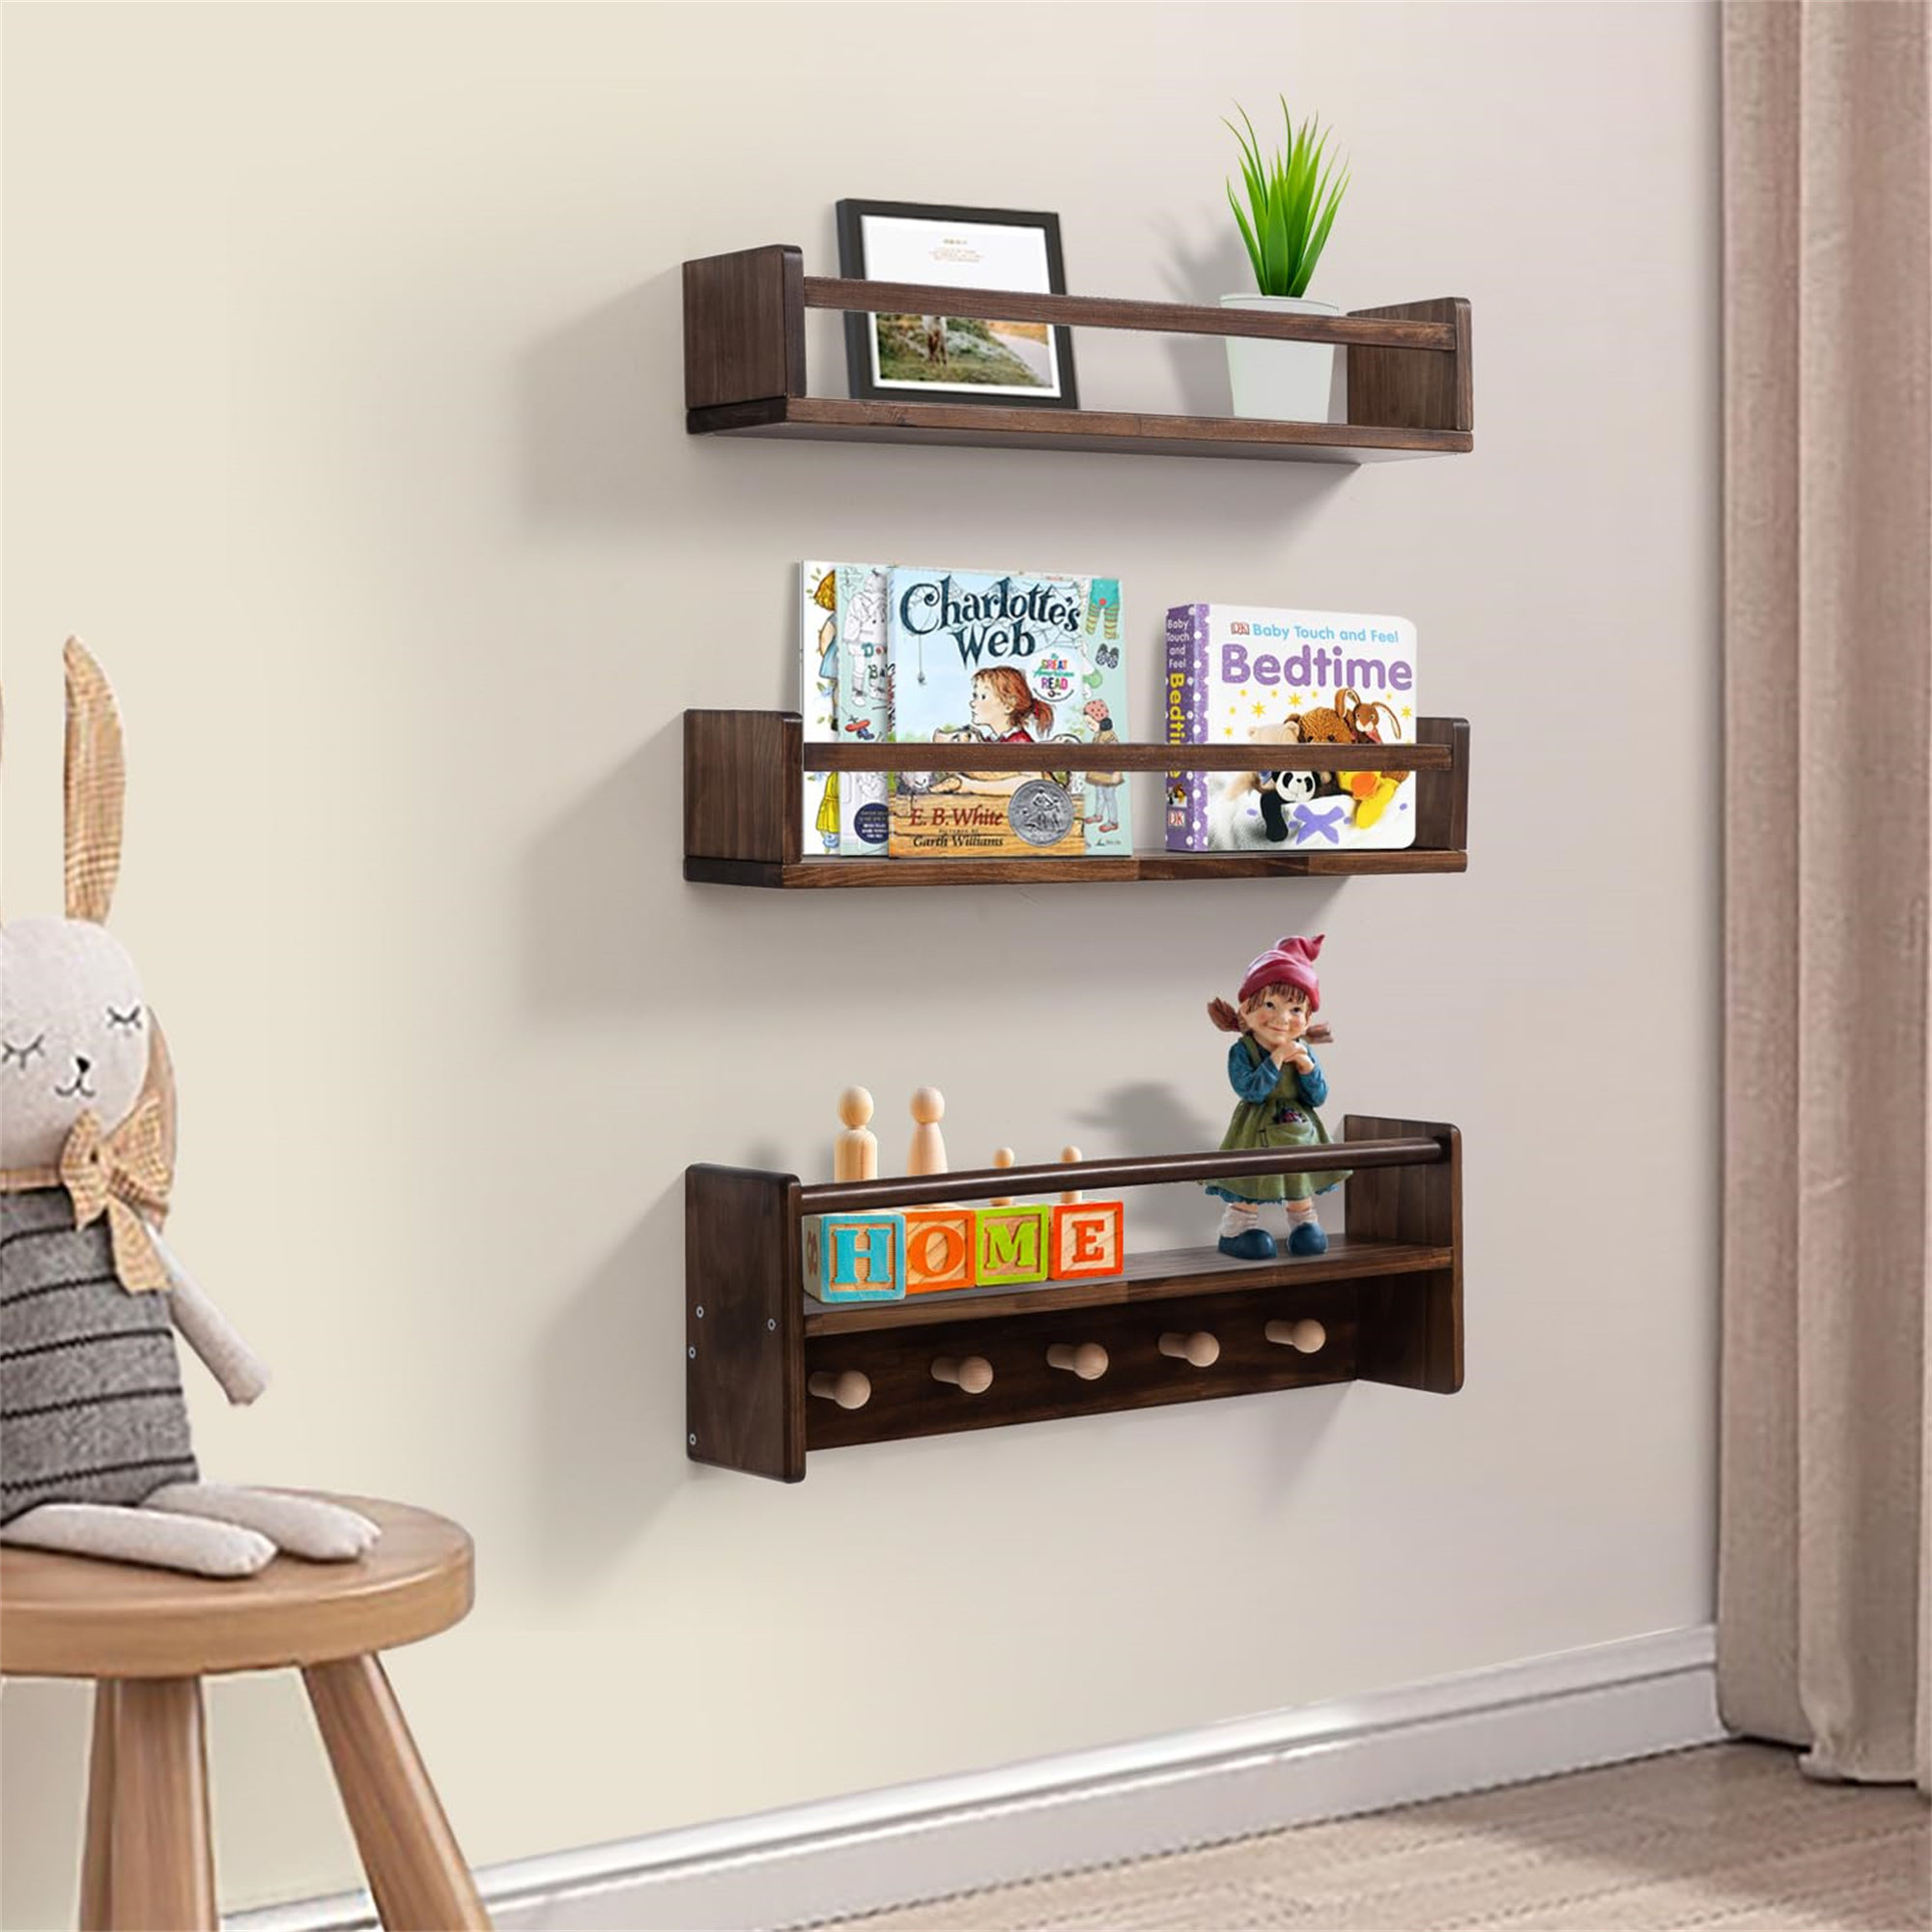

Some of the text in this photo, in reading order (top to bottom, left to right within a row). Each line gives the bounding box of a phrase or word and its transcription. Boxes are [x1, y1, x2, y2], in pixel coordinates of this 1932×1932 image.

[900, 575, 1081, 635] Charlotte's
[1167, 618, 1189, 630] Baby
[1166, 633, 1190, 642] Touch
[1253, 623, 1399, 643] Baby Touch and Feel
[949, 619, 1036, 668] Web
[1169, 644, 1185, 656] and
[1041, 659, 1068, 669] GREAT
[1169, 659, 1186, 668] Feel
[1222, 642, 1412, 691] Bedtime
[1041, 676, 1068, 690] READ
[1169, 673, 1185, 779] Bedti
[909, 807, 926, 826] E.
[931, 807, 949, 826] B.
[952, 804, 1004, 826] White
[913, 833, 1004, 847] Garth Williams
